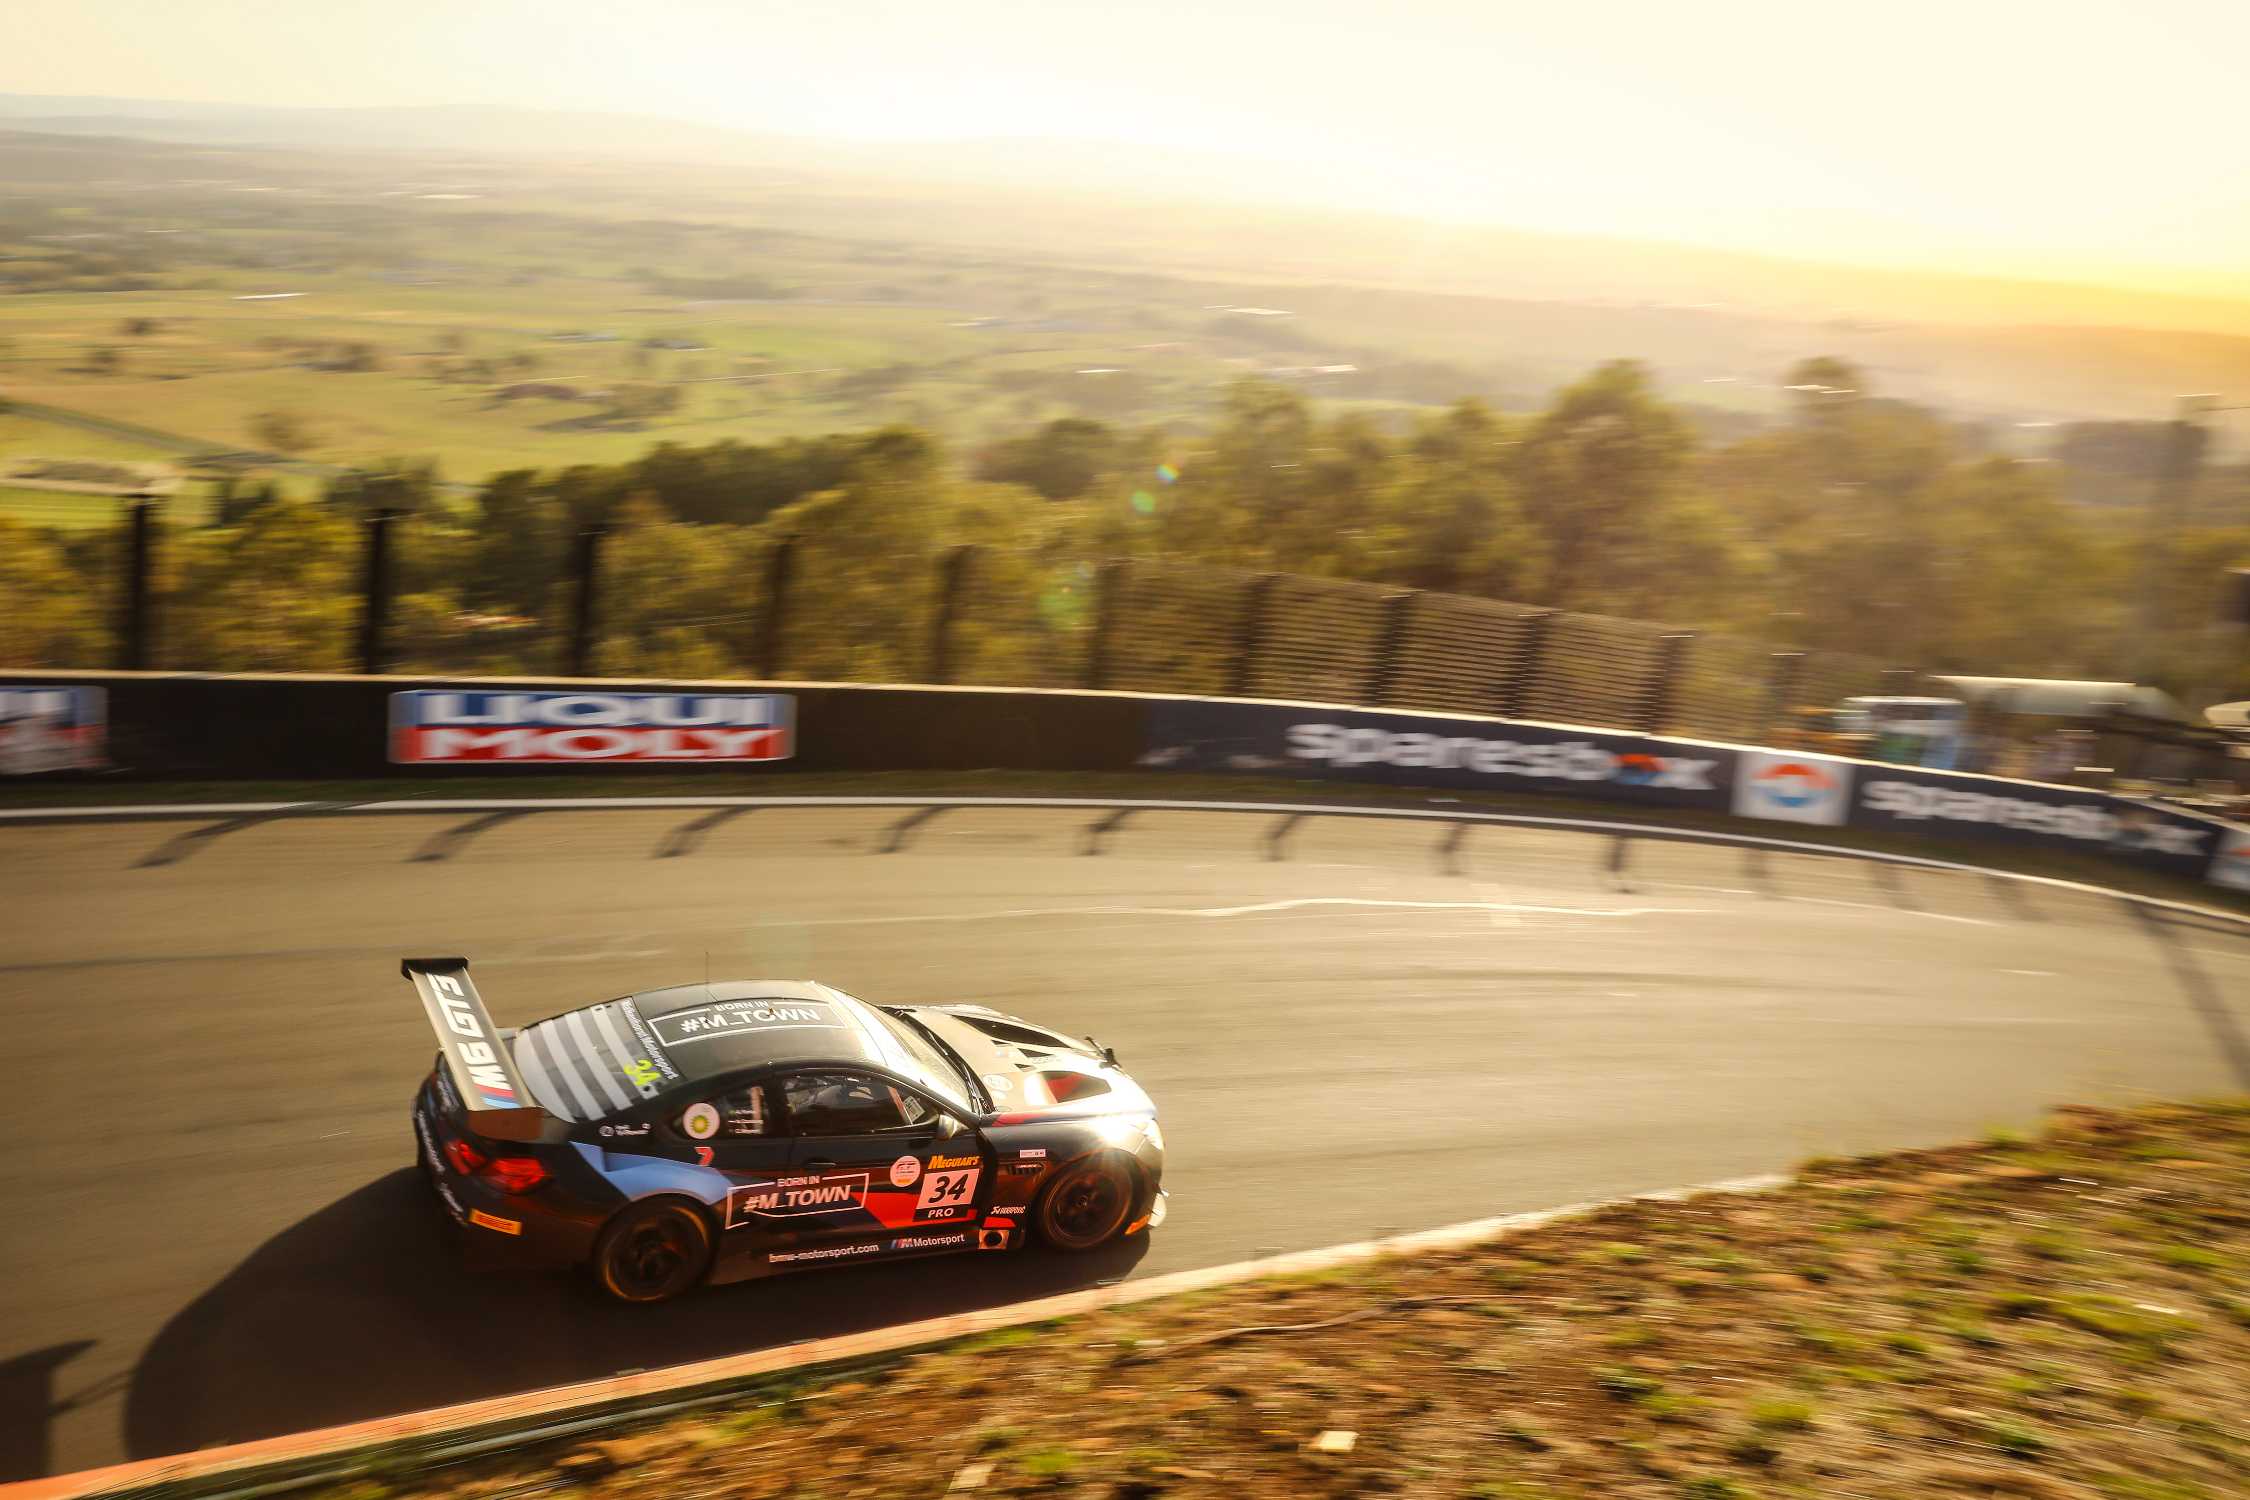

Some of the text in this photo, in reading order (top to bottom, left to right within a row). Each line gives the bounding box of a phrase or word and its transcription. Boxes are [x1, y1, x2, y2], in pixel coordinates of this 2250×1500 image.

[420, 694, 774, 727] LIQUI
[418, 728, 784, 758] MOLY
[715, 999, 769, 1012] BORN IN
[680, 1008, 821, 1033] #M_TOWN
[623, 1059, 661, 1086] 34
[777, 1175, 820, 1188] BORN IN
[928, 1173, 969, 1204] 34
[744, 1185, 850, 1213] #M_TOWN
[928, 1207, 954, 1218] PRO
[769, 1243, 879, 1263] bmw-motorsport.com
[914, 1233, 965, 1248] Motorsport
